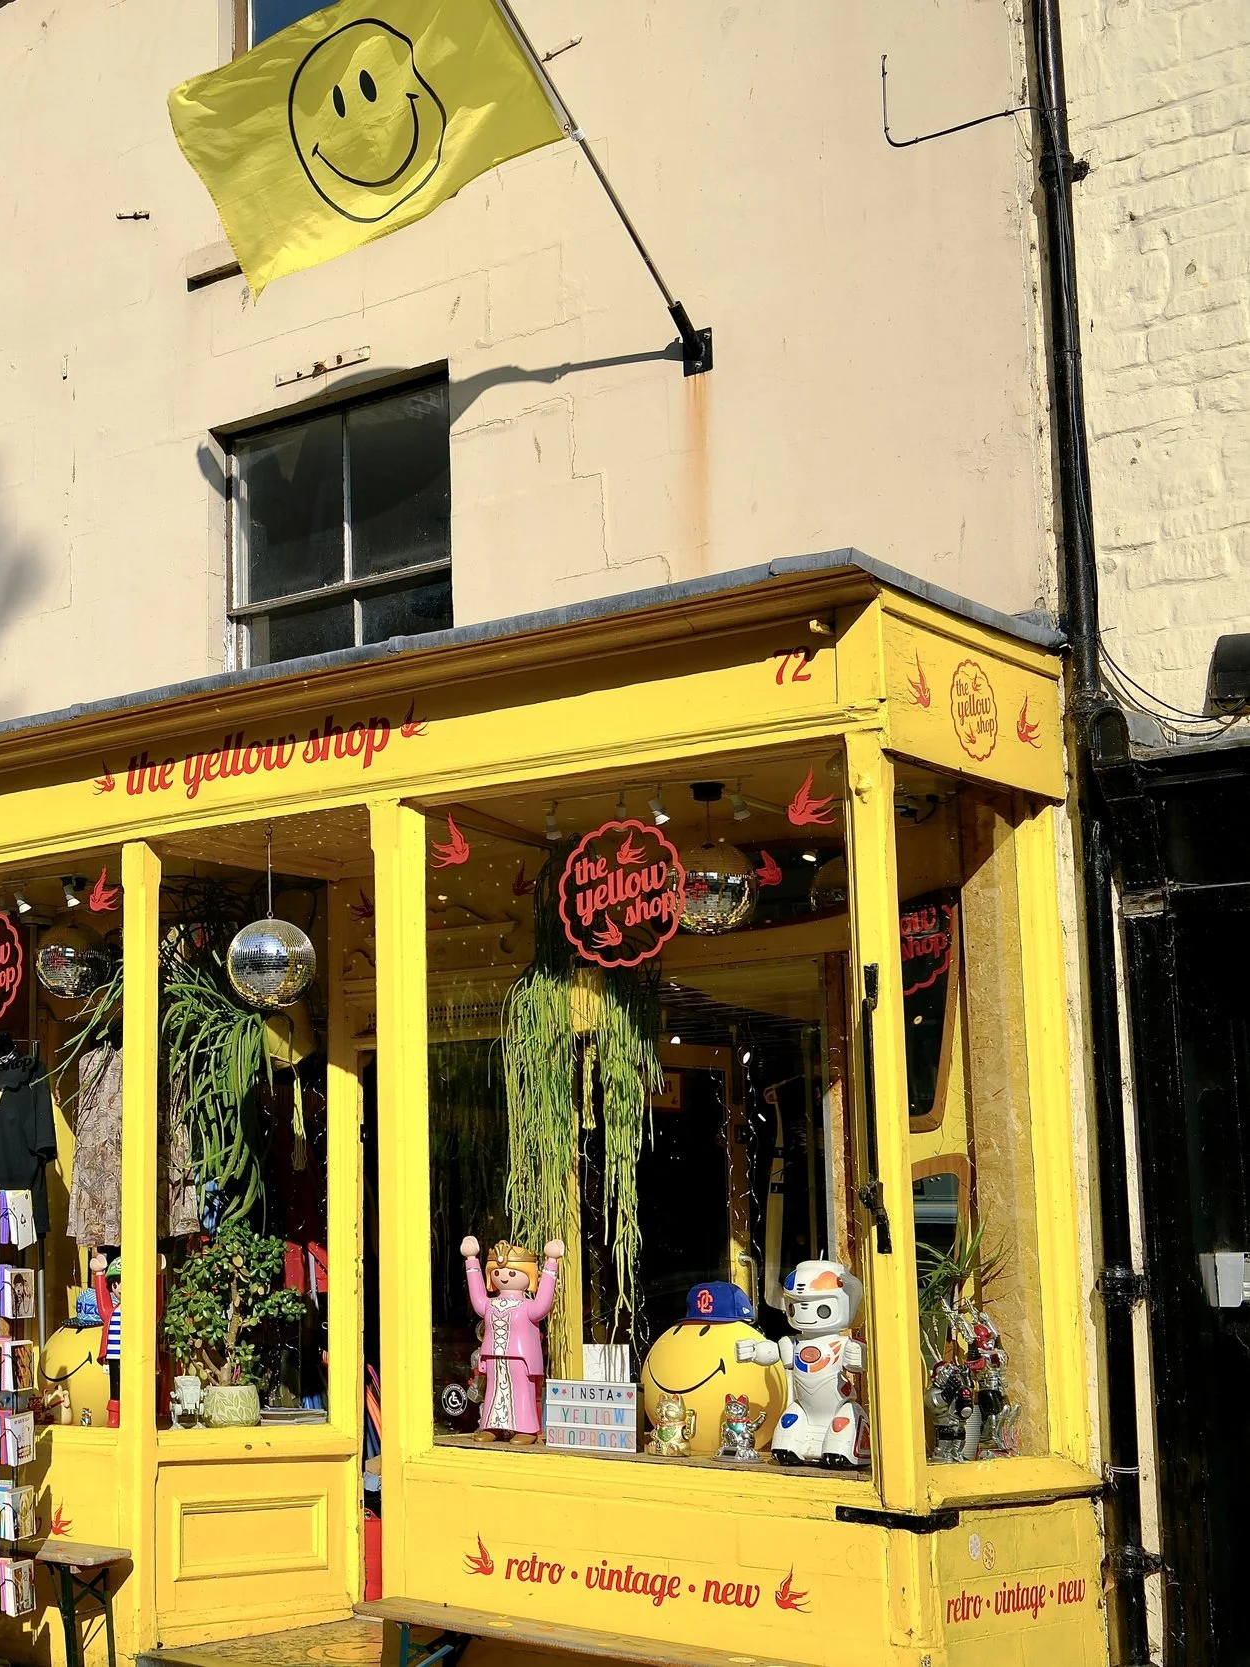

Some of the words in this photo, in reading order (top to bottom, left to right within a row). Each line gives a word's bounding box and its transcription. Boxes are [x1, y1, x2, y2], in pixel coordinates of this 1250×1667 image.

[773, 645, 812, 685] 72
[956, 679, 969, 697] the
[957, 694, 991, 726] yellow
[976, 716, 995, 737] shop
[126, 751, 175, 796] the
[182, 730, 296, 800] yellow
[302, 714, 391, 770] shop
[574, 855, 608, 886] the
[576, 861, 667, 927] yellow
[624, 890, 675, 927] shop
[571, 1387, 614, 1401] INSTA
[562, 1408, 625, 1425] YELLOW
[505, 1551, 565, 1584] retro
[585, 1559, 682, 1607] vintage
[703, 1579, 760, 1609] new
[946, 1590, 983, 1625] retro
[994, 1581, 1046, 1620] vintage
[1058, 1577, 1086, 1605] new
